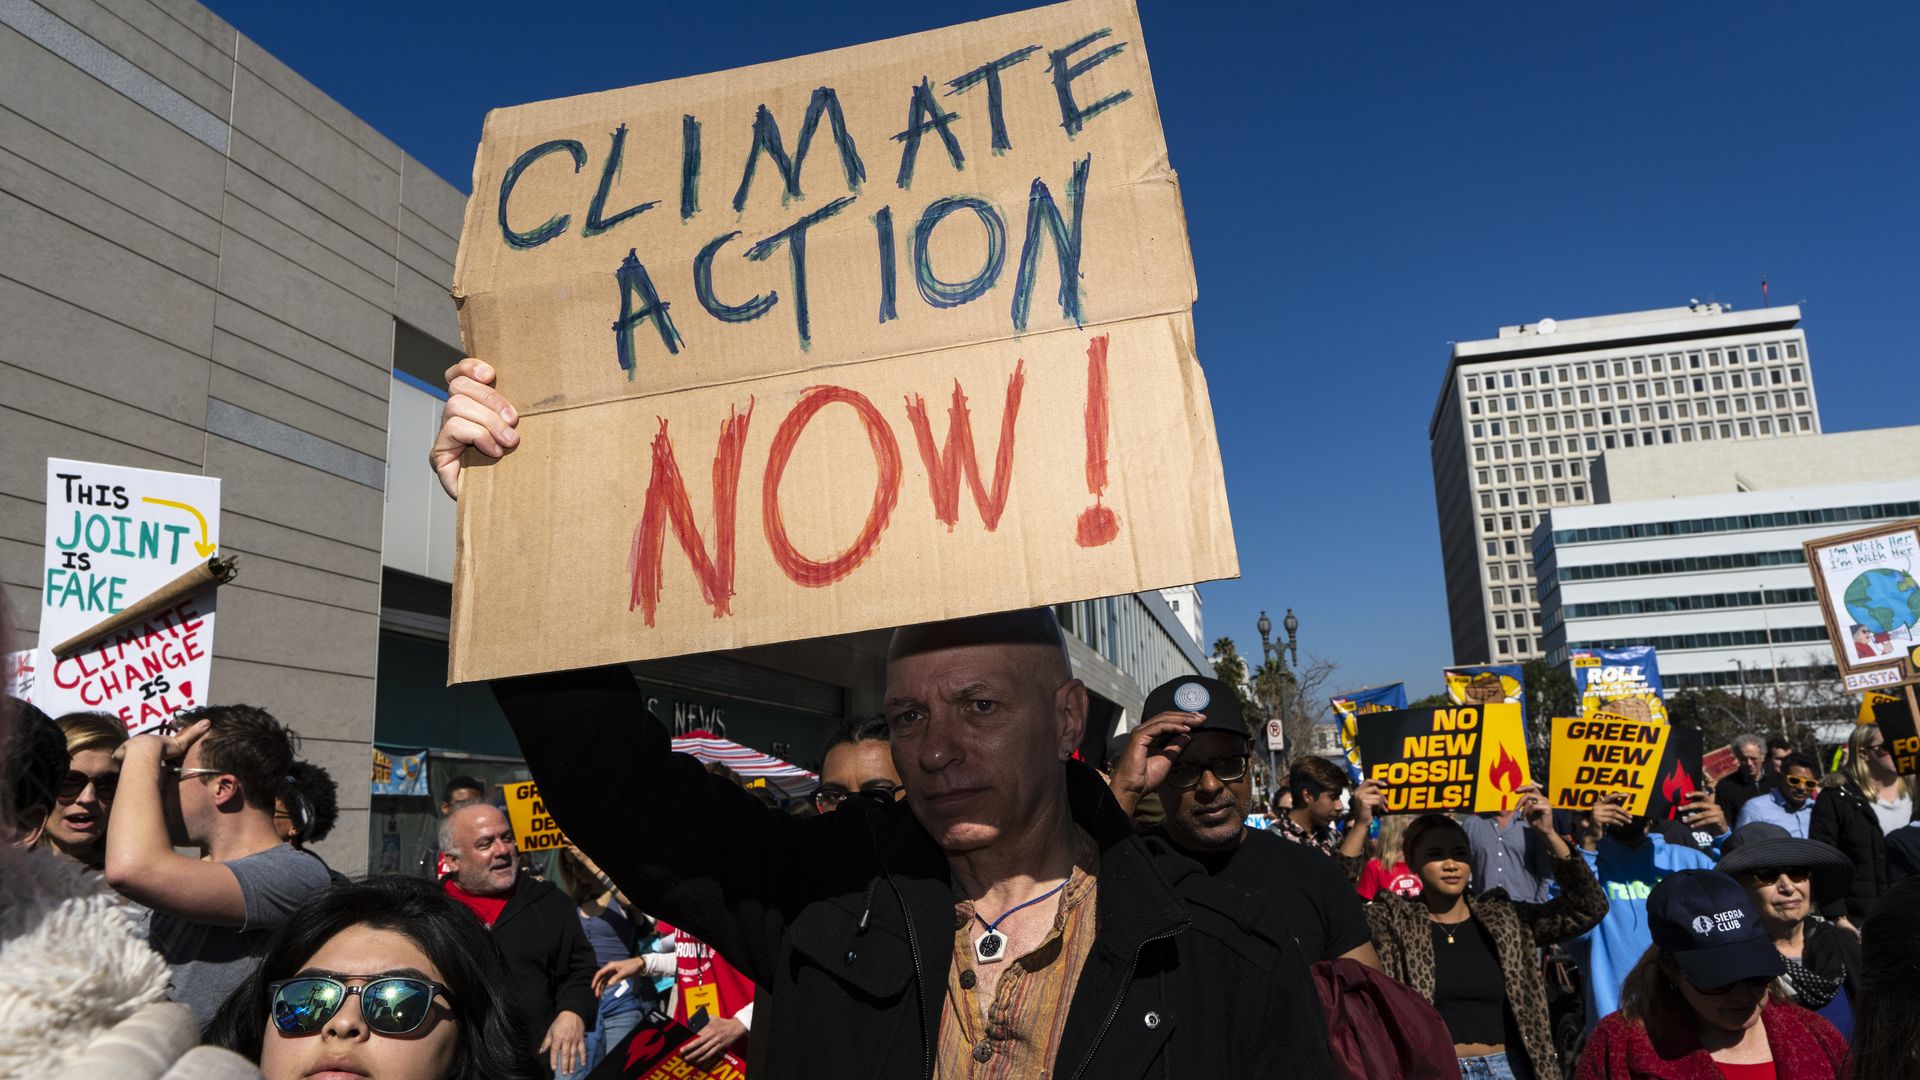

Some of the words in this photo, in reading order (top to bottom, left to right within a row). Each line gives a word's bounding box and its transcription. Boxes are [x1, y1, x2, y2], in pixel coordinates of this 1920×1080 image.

[498, 27, 1132, 250] CLIMATE
[612, 153, 1090, 380] ACTION
[56, 473, 129, 509] THIS
[628, 333, 1120, 628] NOW!
[56, 511, 190, 565] JOINT
[1852, 540, 1884, 554] With
[1889, 535, 1912, 548] Her
[61, 551, 91, 571] IS
[1856, 551, 1887, 564] With
[1891, 546, 1913, 557] Her
[46, 568, 127, 614] FAKE
[53, 598, 204, 689] CLIMATE
[80, 632, 204, 706] CHANGE
[1586, 665, 1646, 684] ROLL
[1847, 670, 1899, 688] BASTA
[139, 674, 171, 701] IS
[118, 681, 195, 732] EAL!
[675, 702, 726, 739] NEWS
[1433, 708, 1478, 732] NO
[1567, 721, 1661, 745] GREEN
[1403, 733, 1477, 759] NEW
[1583, 744, 1654, 766] NEW
[1372, 759, 1474, 785] FOSSIL
[1575, 766, 1644, 789] DEAL
[1558, 788, 1637, 811] NO!
[531, 817, 558, 832] DE
[1714, 909, 1745, 923] SIERRA
[1717, 919, 1741, 932] CLUB
